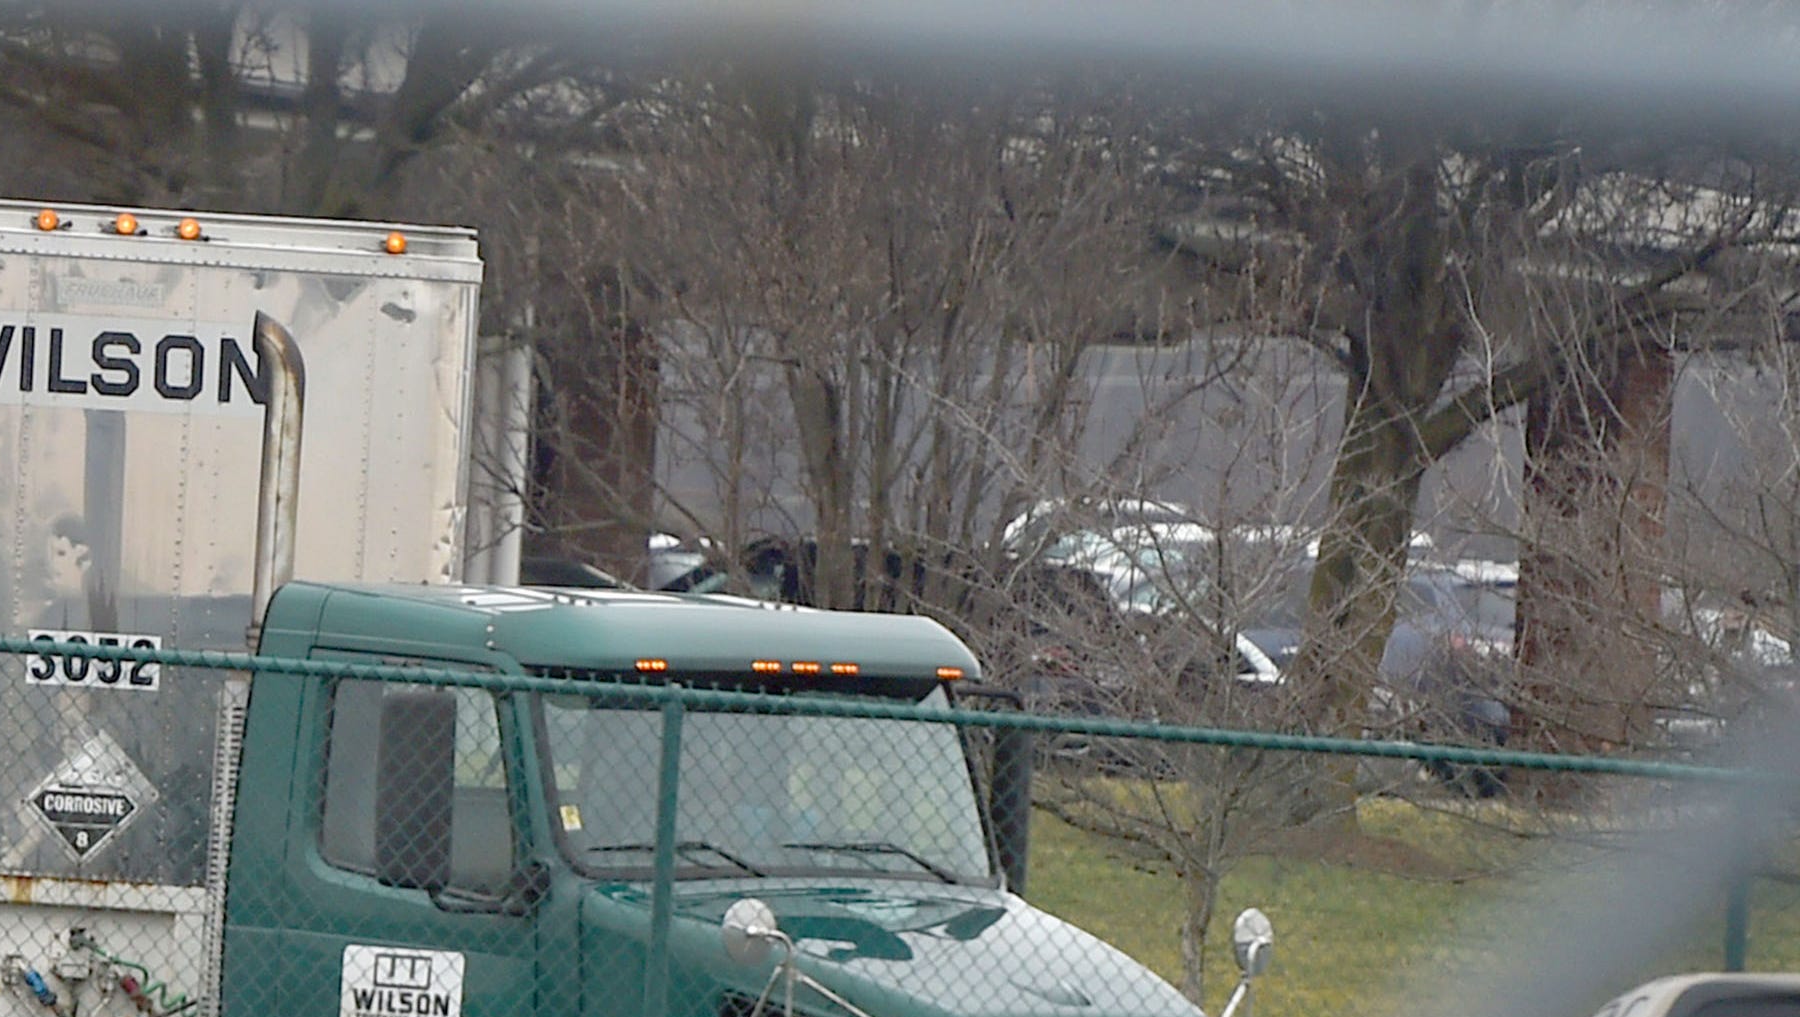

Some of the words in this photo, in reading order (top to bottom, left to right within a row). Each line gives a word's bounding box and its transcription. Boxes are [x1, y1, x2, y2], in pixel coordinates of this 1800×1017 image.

[31, 634, 155, 686] 3052
[44, 794, 125, 816] CORROSIVE
[76, 831, 89, 848] 8
[353, 987, 450, 1017] WILSON
